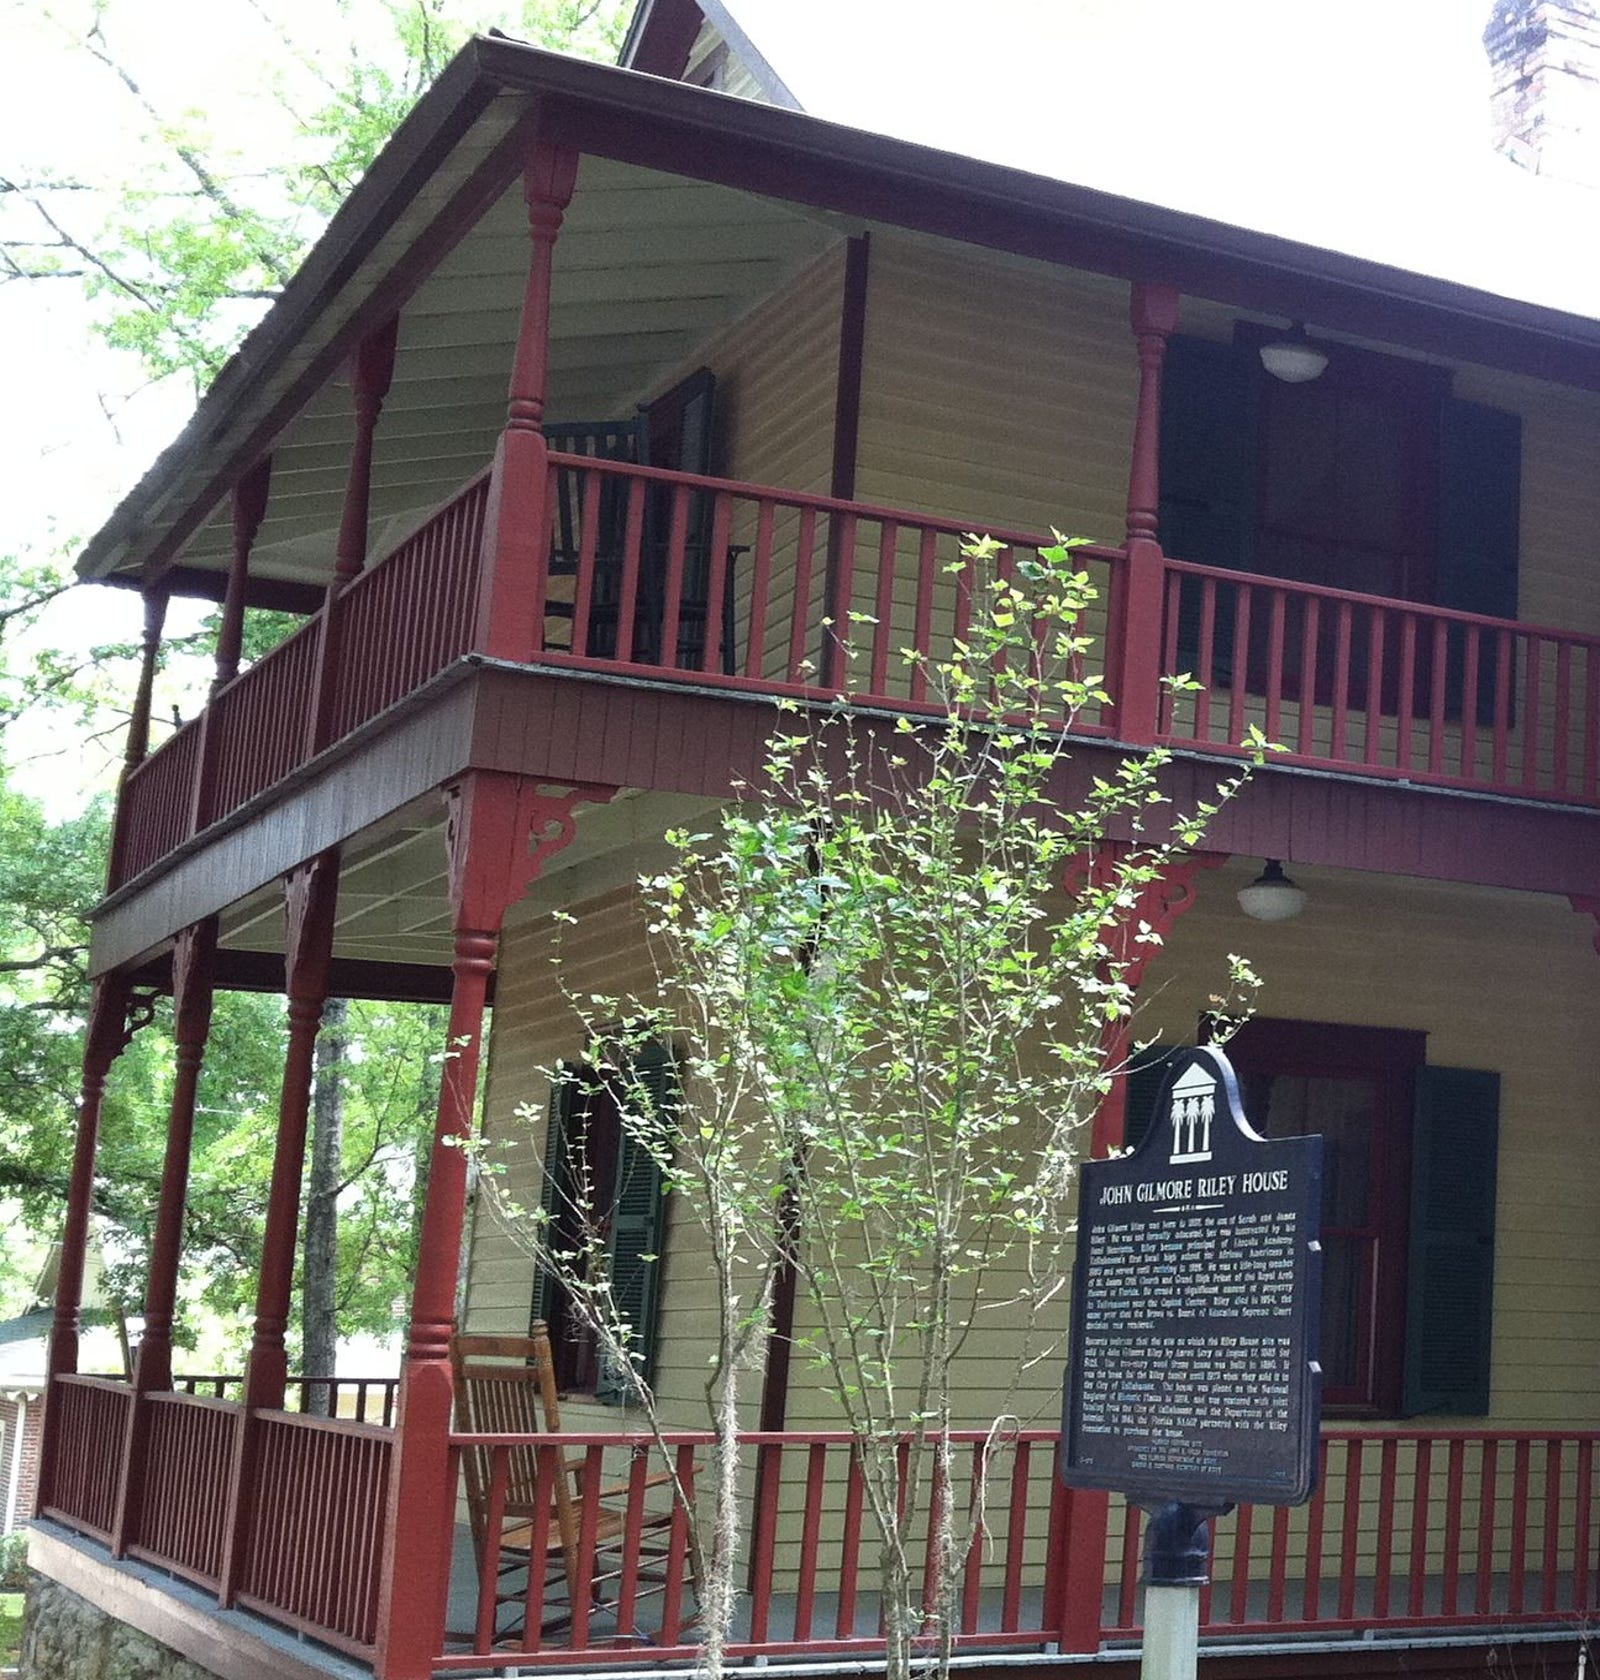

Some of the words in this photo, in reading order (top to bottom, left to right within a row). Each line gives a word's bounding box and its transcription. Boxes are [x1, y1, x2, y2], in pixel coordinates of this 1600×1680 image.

[1100, 1185, 1133, 1205] JOHN
[1136, 1180, 1192, 1202] GILMORE
[1197, 1175, 1237, 1197] RILEY
[1242, 1170, 1288, 1193] HOUSE
